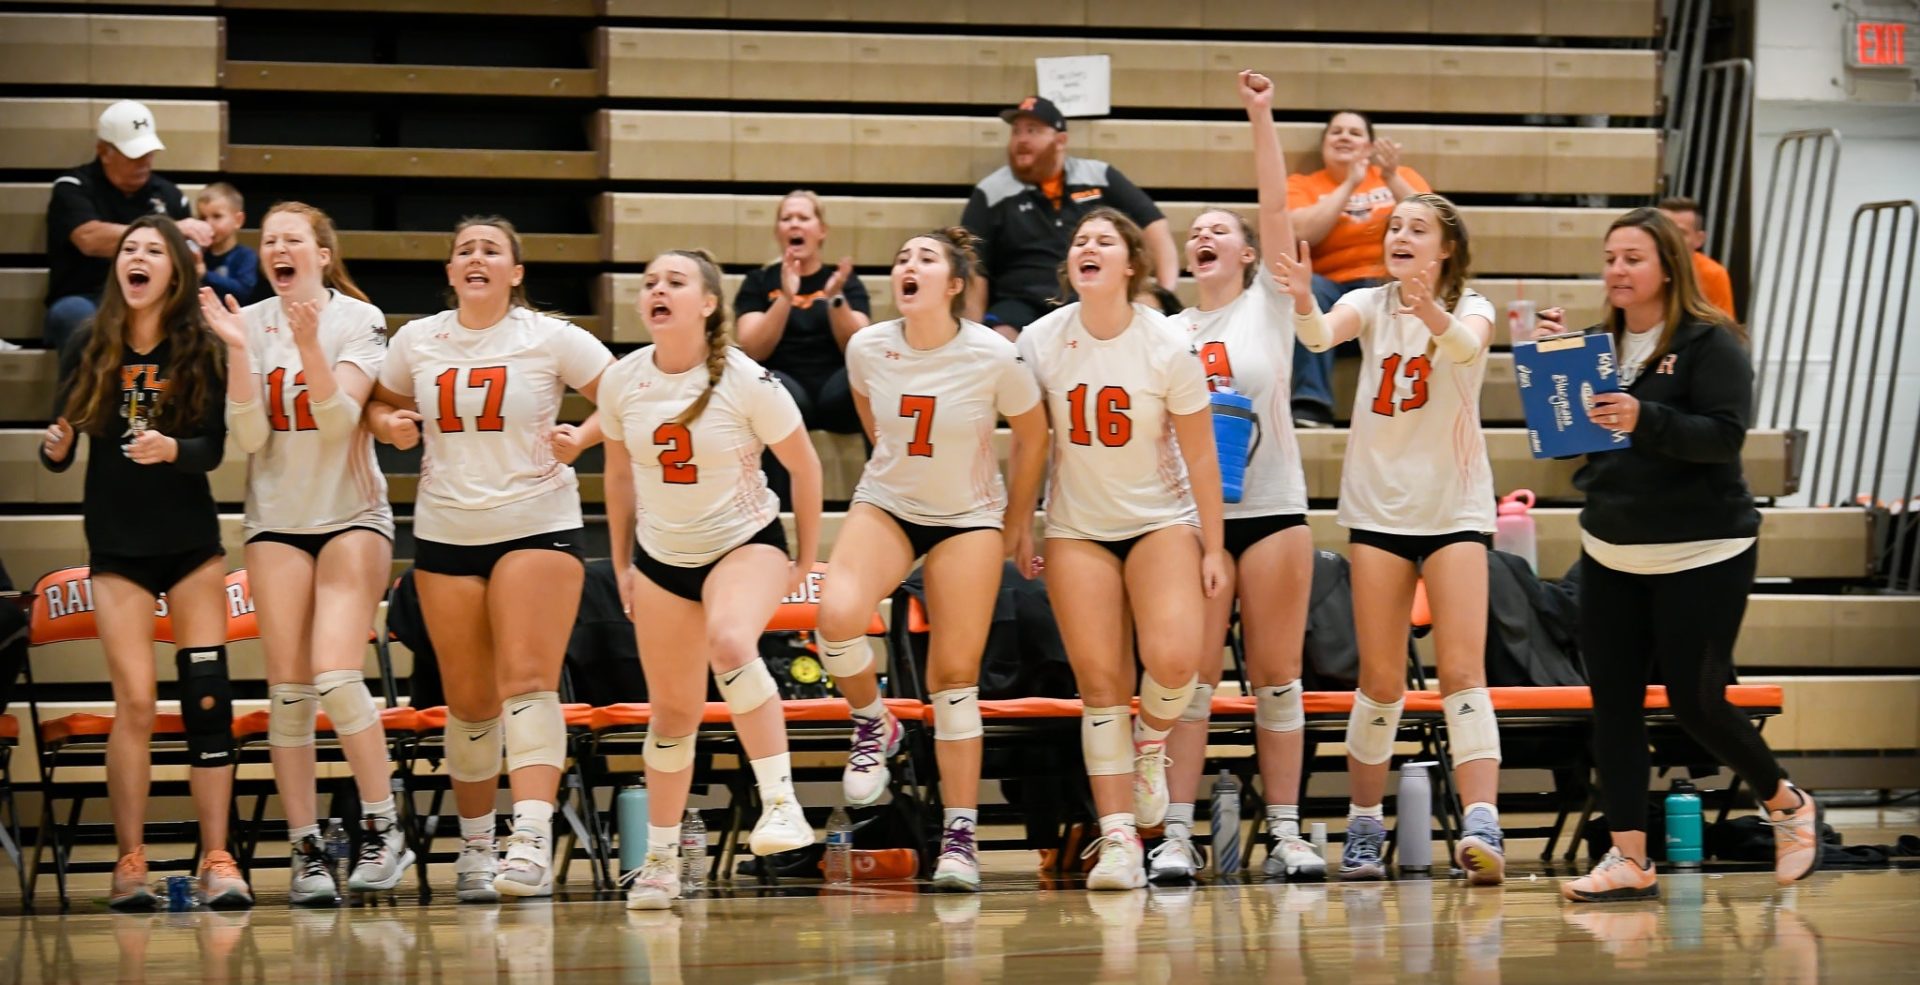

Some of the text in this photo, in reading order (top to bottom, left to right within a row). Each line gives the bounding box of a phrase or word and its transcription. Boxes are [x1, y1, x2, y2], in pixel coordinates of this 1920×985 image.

[1858, 22, 1905, 65] EXIT
[1371, 352, 1434, 417] 13
[1656, 353, 1678, 375] R
[267, 366, 320, 432] 12
[434, 365, 508, 434] 17
[899, 394, 937, 458] 7
[1066, 383, 1133, 447] 16
[653, 422, 698, 485] 2
